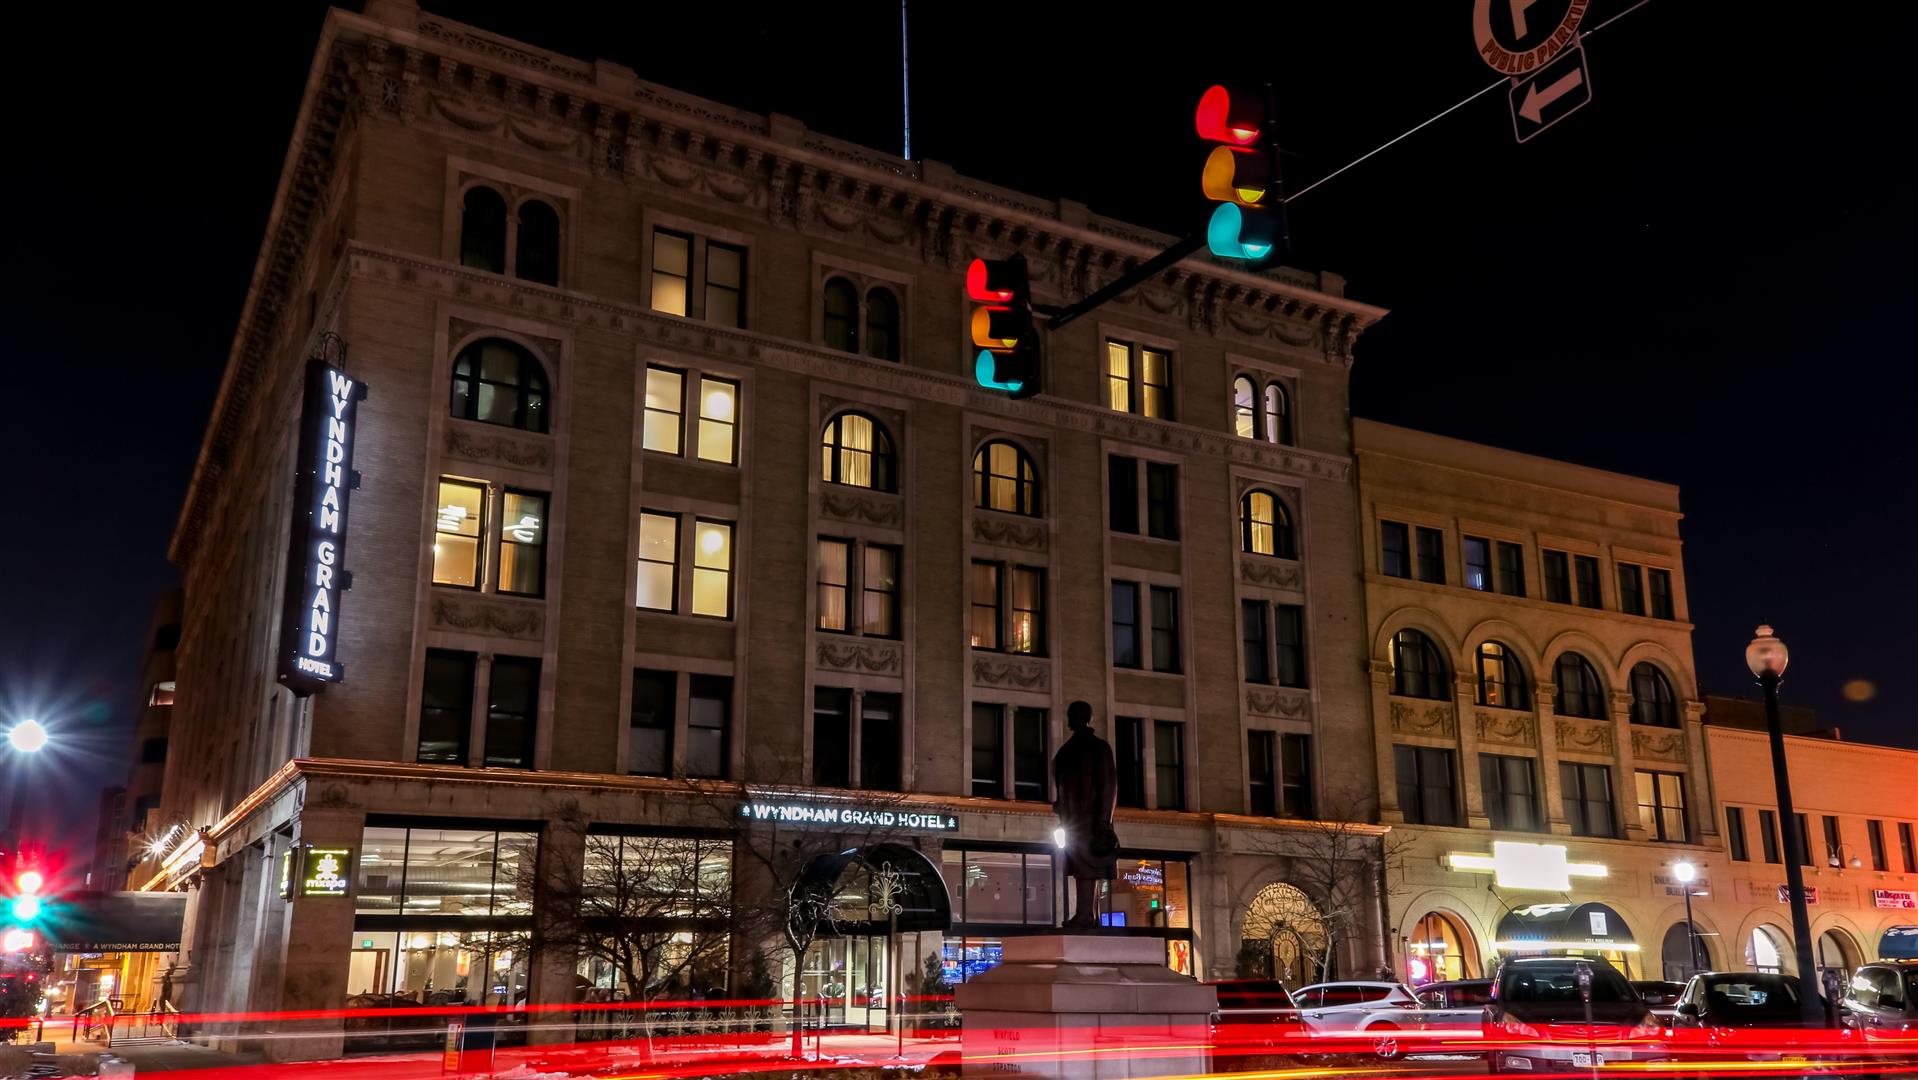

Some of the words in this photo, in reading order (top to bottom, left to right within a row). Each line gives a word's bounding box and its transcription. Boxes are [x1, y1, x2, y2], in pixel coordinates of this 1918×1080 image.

[1482, 39, 1535, 73] PUBLIC
[1536, 0, 1589, 65] PARKI
[320, 370, 353, 533] WYNDHAM
[309, 541, 335, 656] GRAND
[299, 656, 333, 677] HOTEL
[753, 804, 838, 823] WYNDHAM
[840, 810, 894, 826] GRAND
[898, 812, 946, 829] HOTEL
